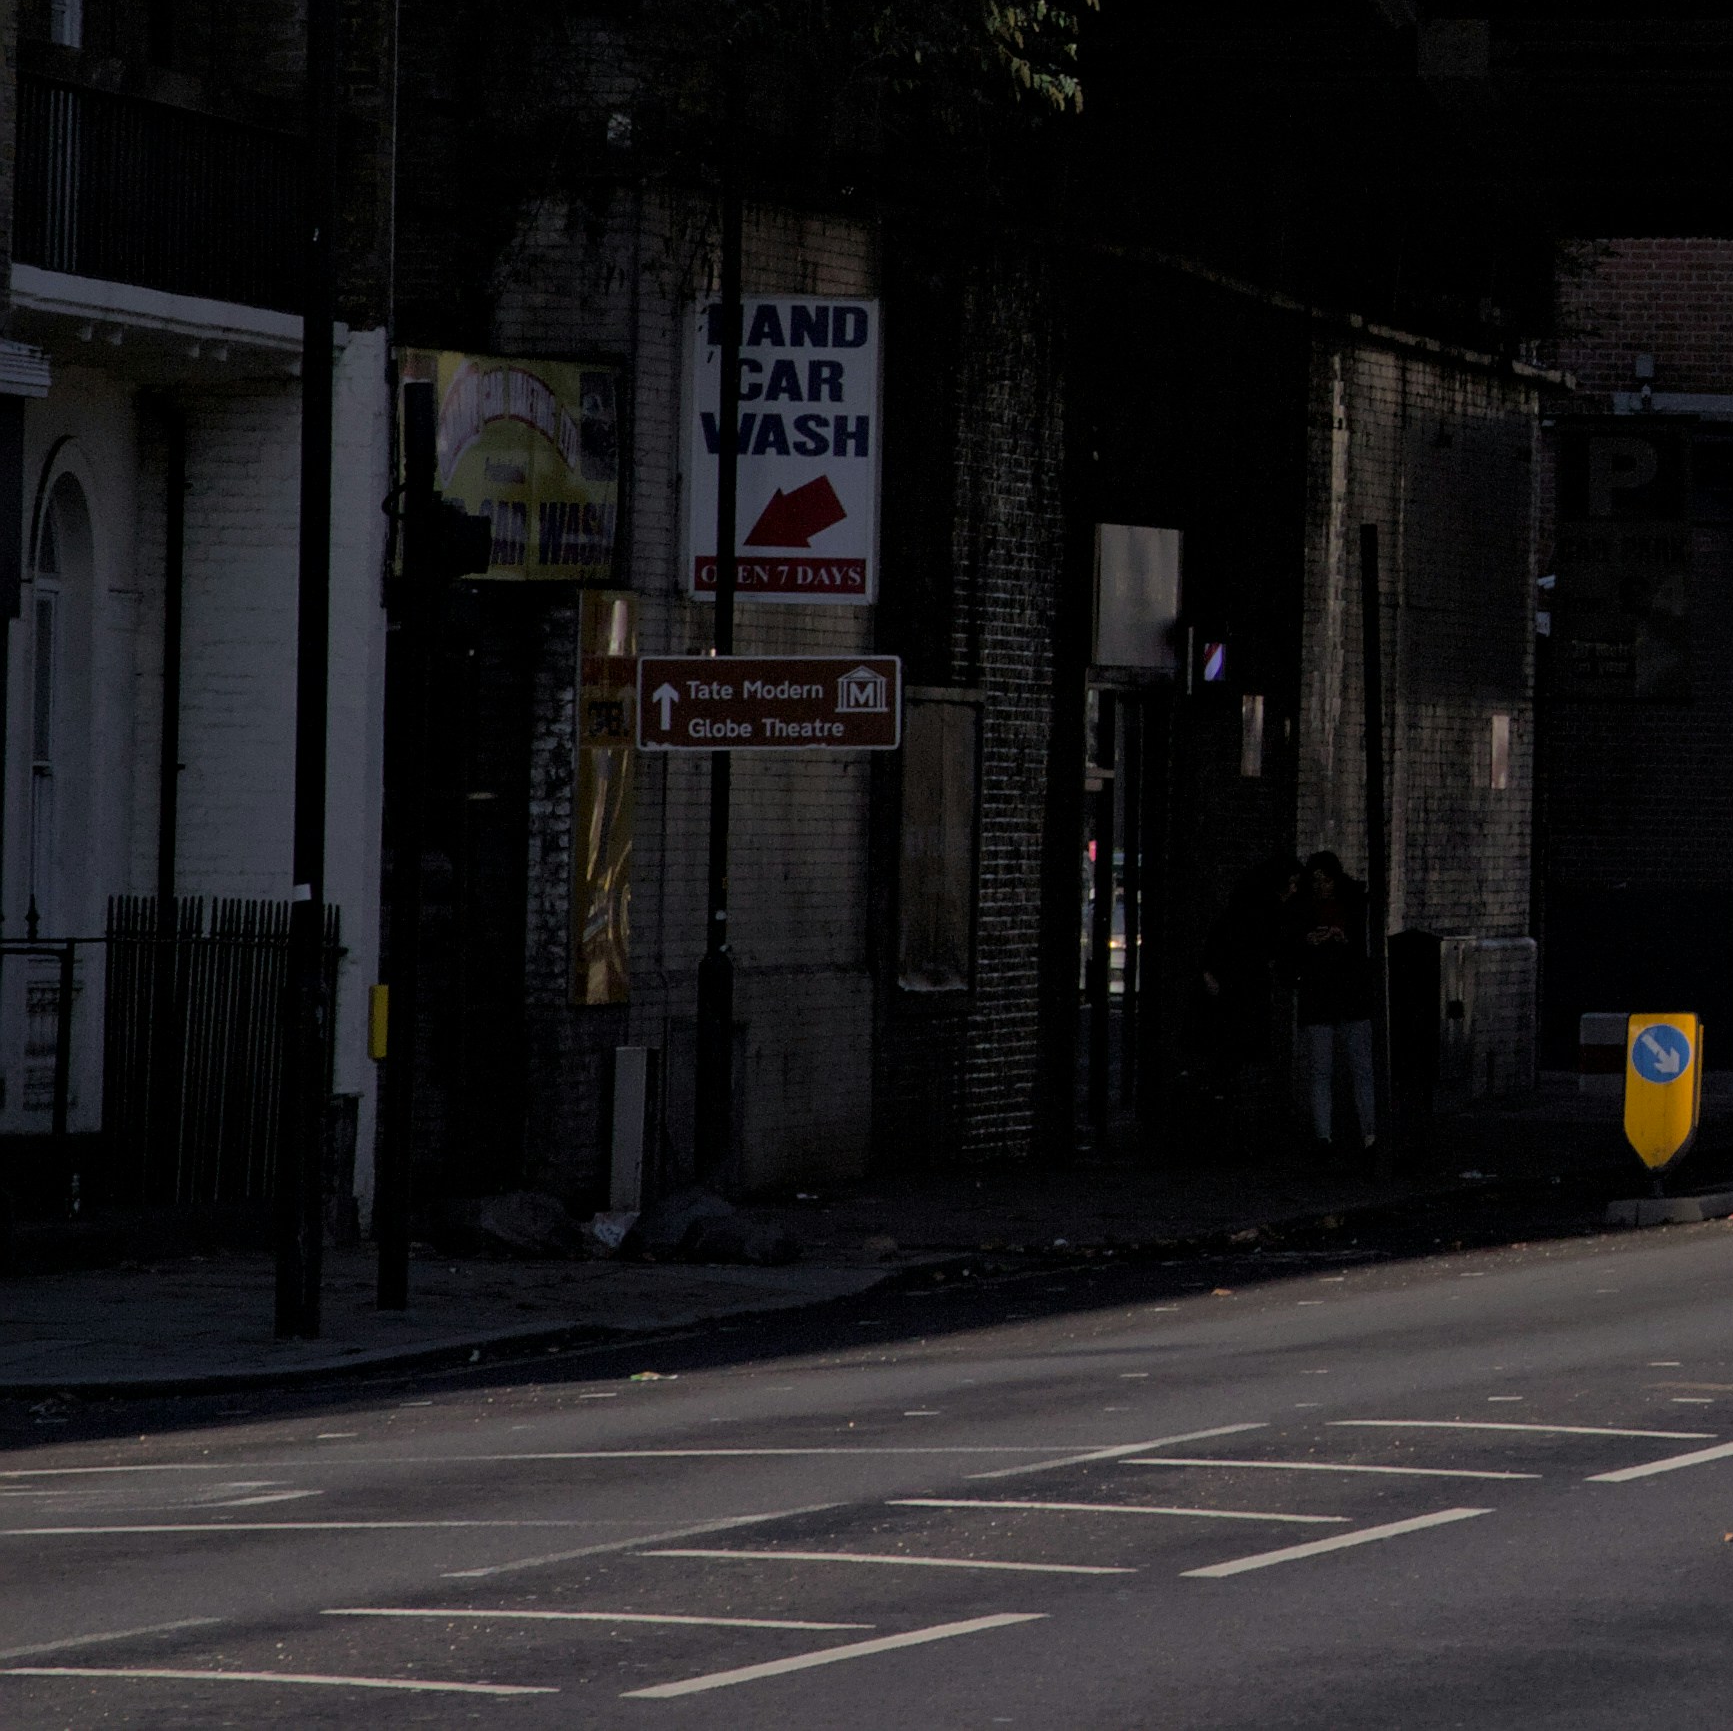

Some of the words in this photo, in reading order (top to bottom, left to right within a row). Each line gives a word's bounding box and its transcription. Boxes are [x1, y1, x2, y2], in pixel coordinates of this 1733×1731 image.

[735, 357, 844, 403] CAR
[699, 411, 870, 458] WASH
[1588, 436, 1659, 516] P
[700, 564, 768, 587] OEN
[776, 566, 790, 587] 7
[796, 567, 863, 588] DAYS
[685, 680, 733, 700] Tate
[742, 680, 824, 700] Modern
[687, 717, 753, 738] Globe
[761, 717, 845, 738] Theatre
